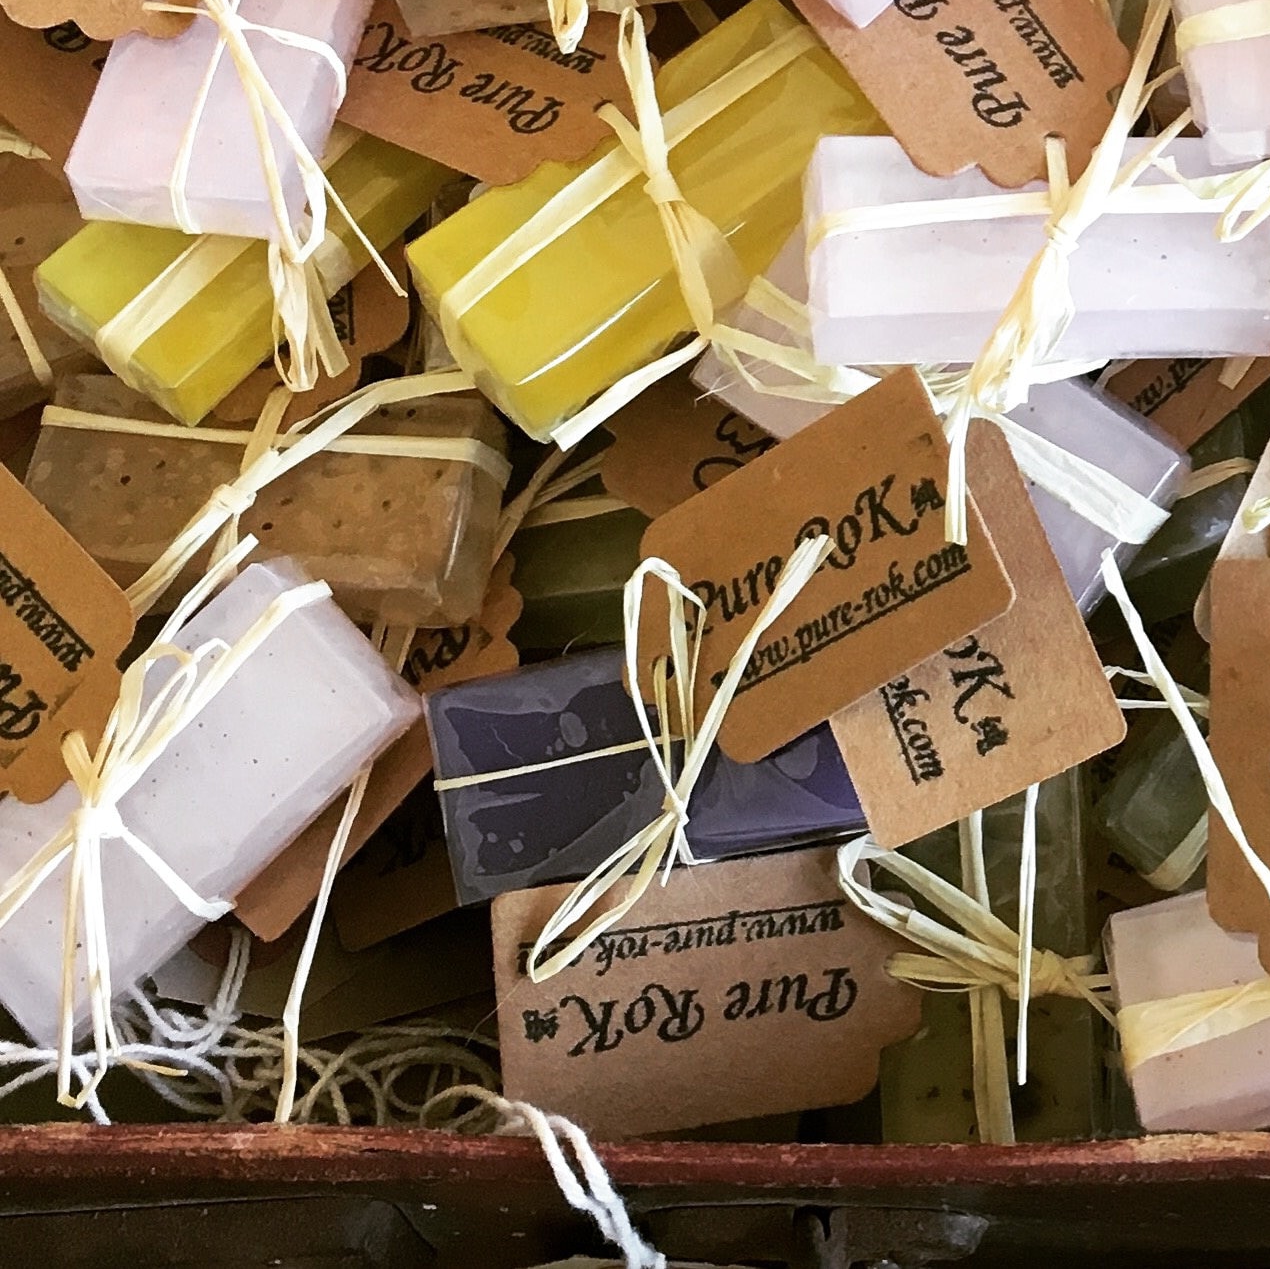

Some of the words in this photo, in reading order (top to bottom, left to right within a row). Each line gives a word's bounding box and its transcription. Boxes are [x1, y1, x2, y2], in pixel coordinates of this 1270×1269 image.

[353, 22, 463, 93] RoK
[936, 25, 1031, 128] Pure
[459, 73, 565, 134] Pure
[560, 984, 705, 1058] RoK
[724, 967, 858, 1022] Pure
